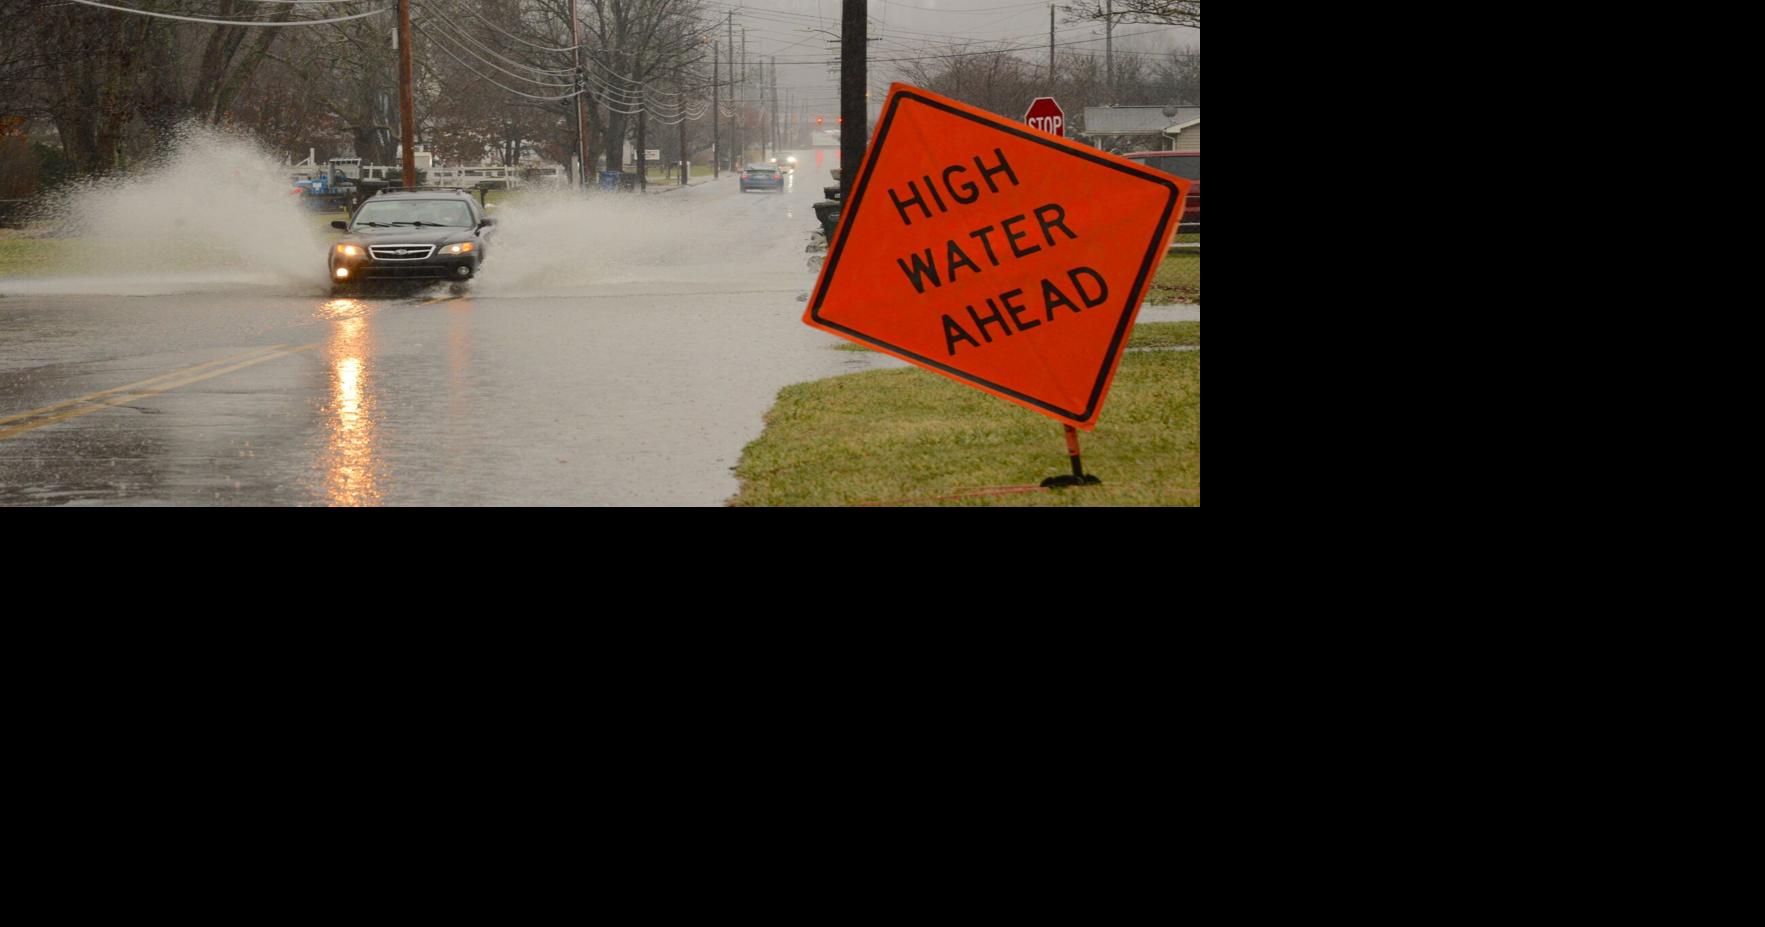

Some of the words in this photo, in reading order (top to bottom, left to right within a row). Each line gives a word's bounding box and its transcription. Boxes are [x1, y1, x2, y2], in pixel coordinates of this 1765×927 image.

[888, 148, 1019, 225] HIGH
[897, 204, 1077, 293] WATER
[942, 267, 1108, 355] AHEAD
